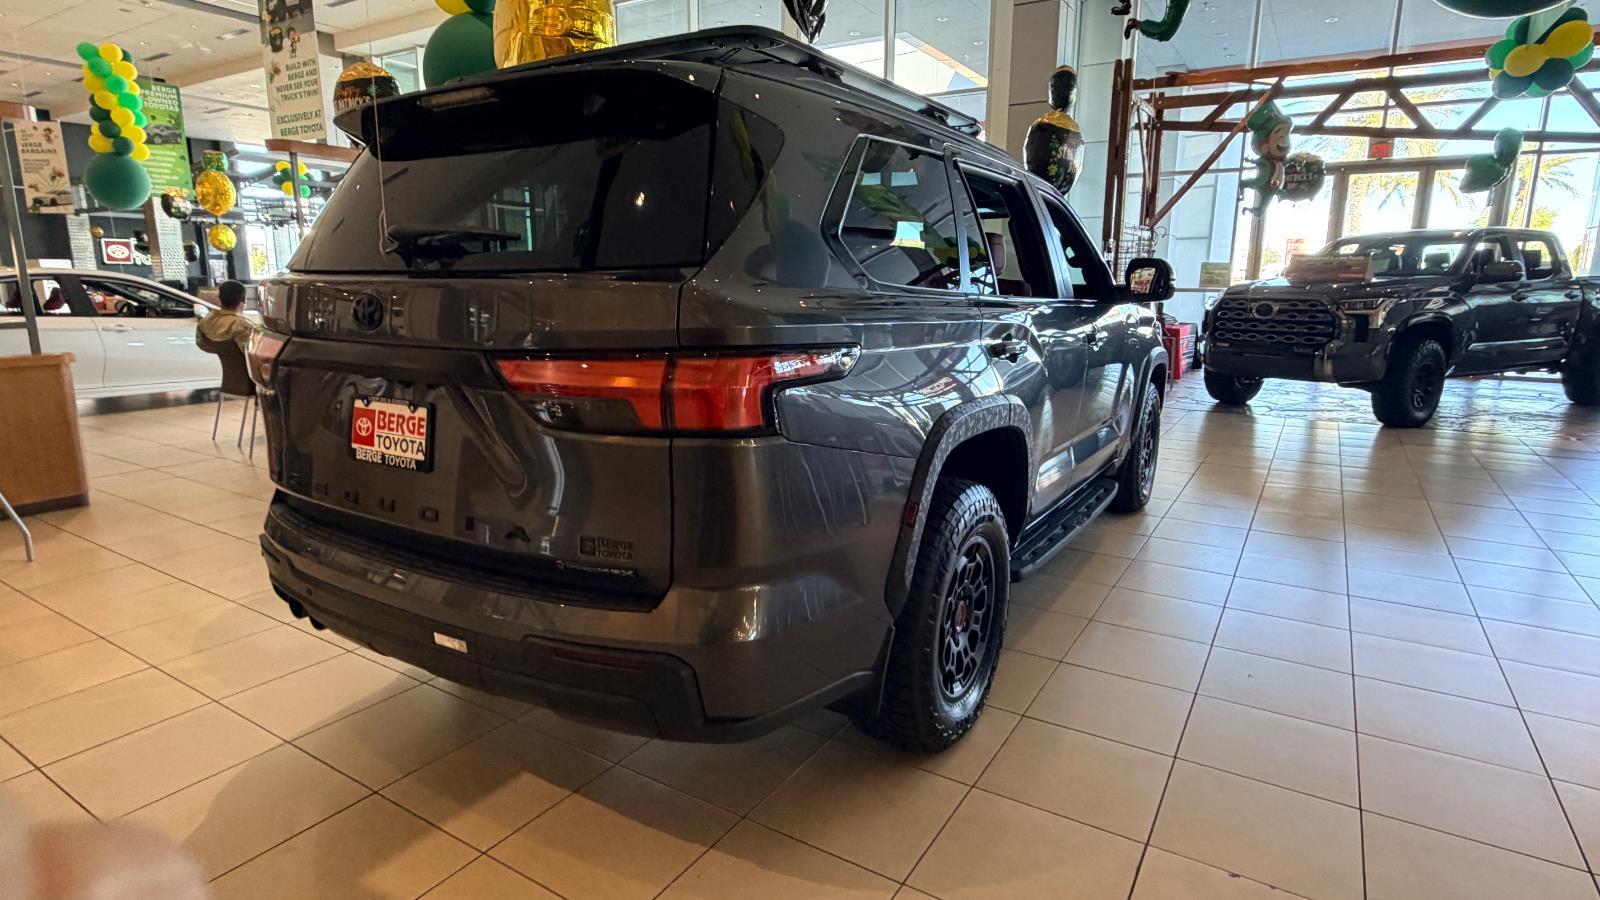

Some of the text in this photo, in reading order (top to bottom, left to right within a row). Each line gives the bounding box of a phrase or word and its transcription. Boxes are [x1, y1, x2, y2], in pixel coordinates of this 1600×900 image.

[285, 58, 317, 72] BUILD WITH
[287, 67, 318, 81] BERGE AND
[275, 78, 319, 93] NEVER SEE YOUR
[280, 91, 303, 102] TRUCK'S
[143, 101, 180, 112] TOYOTAS
[276, 109, 322, 125] EXCLUSIVELY AT
[280, 122, 324, 137] BERGE TOYOTA
[376, 409, 426, 437] BERGE
[376, 434, 426, 457] TOYOTA
[356, 447, 417, 471] BERGE TOYOTA
[597, 536, 633, 551] BERGE
[597, 549, 633, 560] TOYOTA
